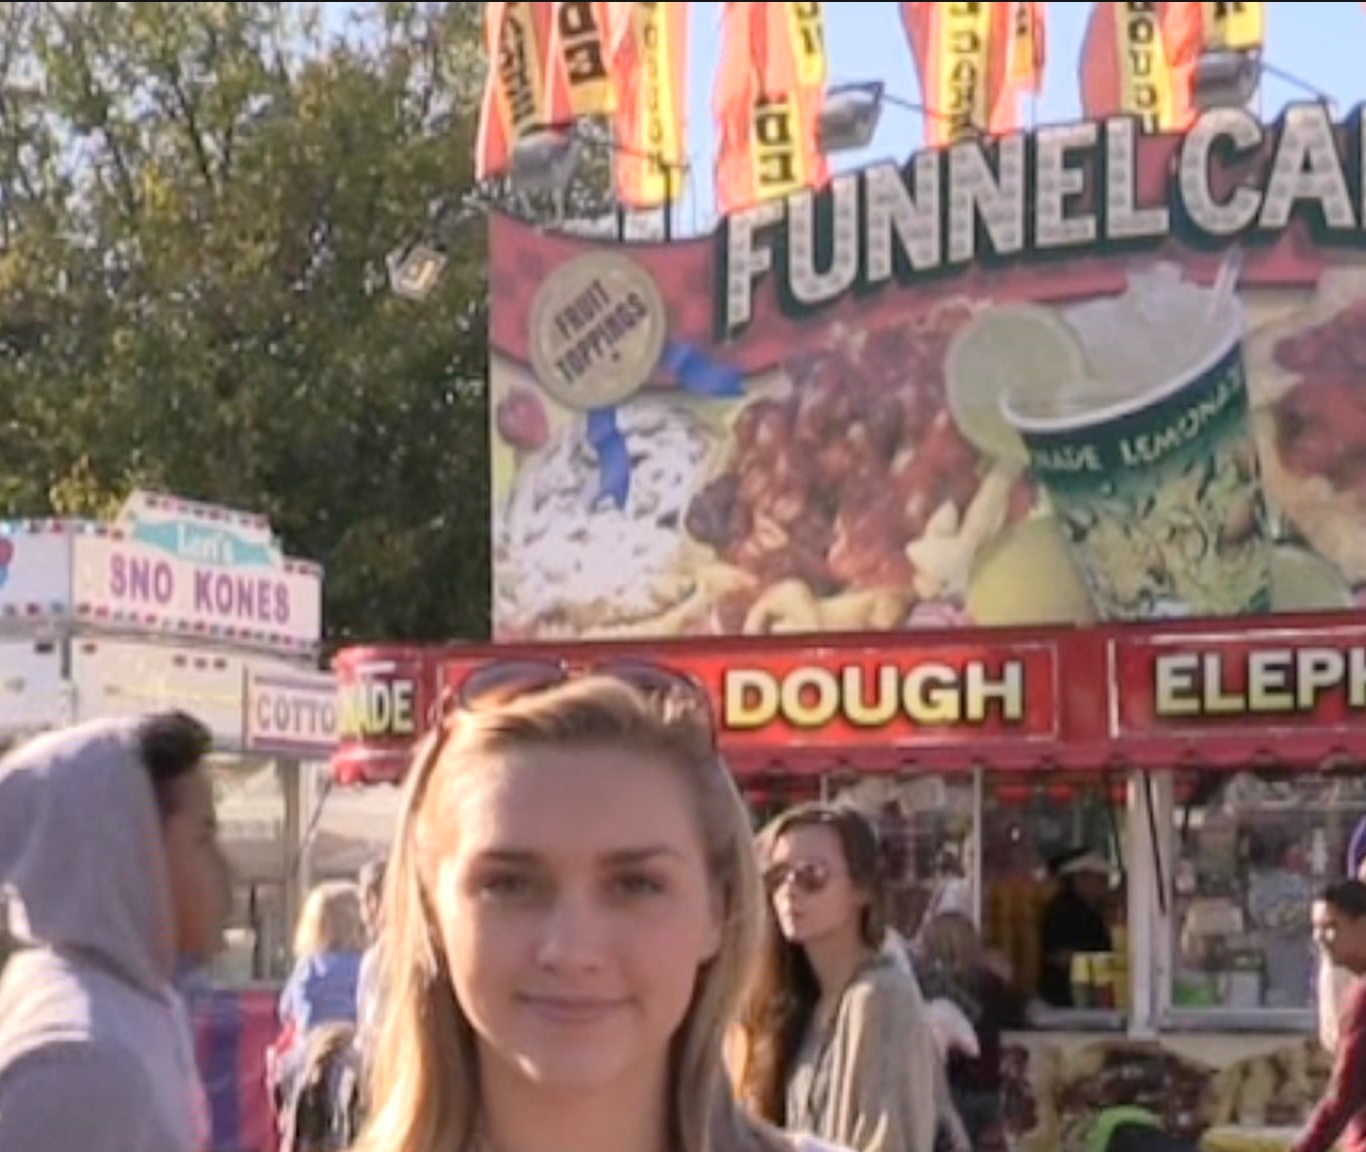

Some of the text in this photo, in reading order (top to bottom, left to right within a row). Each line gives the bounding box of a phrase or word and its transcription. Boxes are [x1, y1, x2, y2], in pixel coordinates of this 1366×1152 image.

[726, 115, 1170, 330] FUNNEL
[554, 278, 611, 339] FRUIT
[556, 292, 648, 385] TOPPINGS
[109, 553, 291, 625] SNO KONES
[723, 660, 1026, 730] DOUGH
